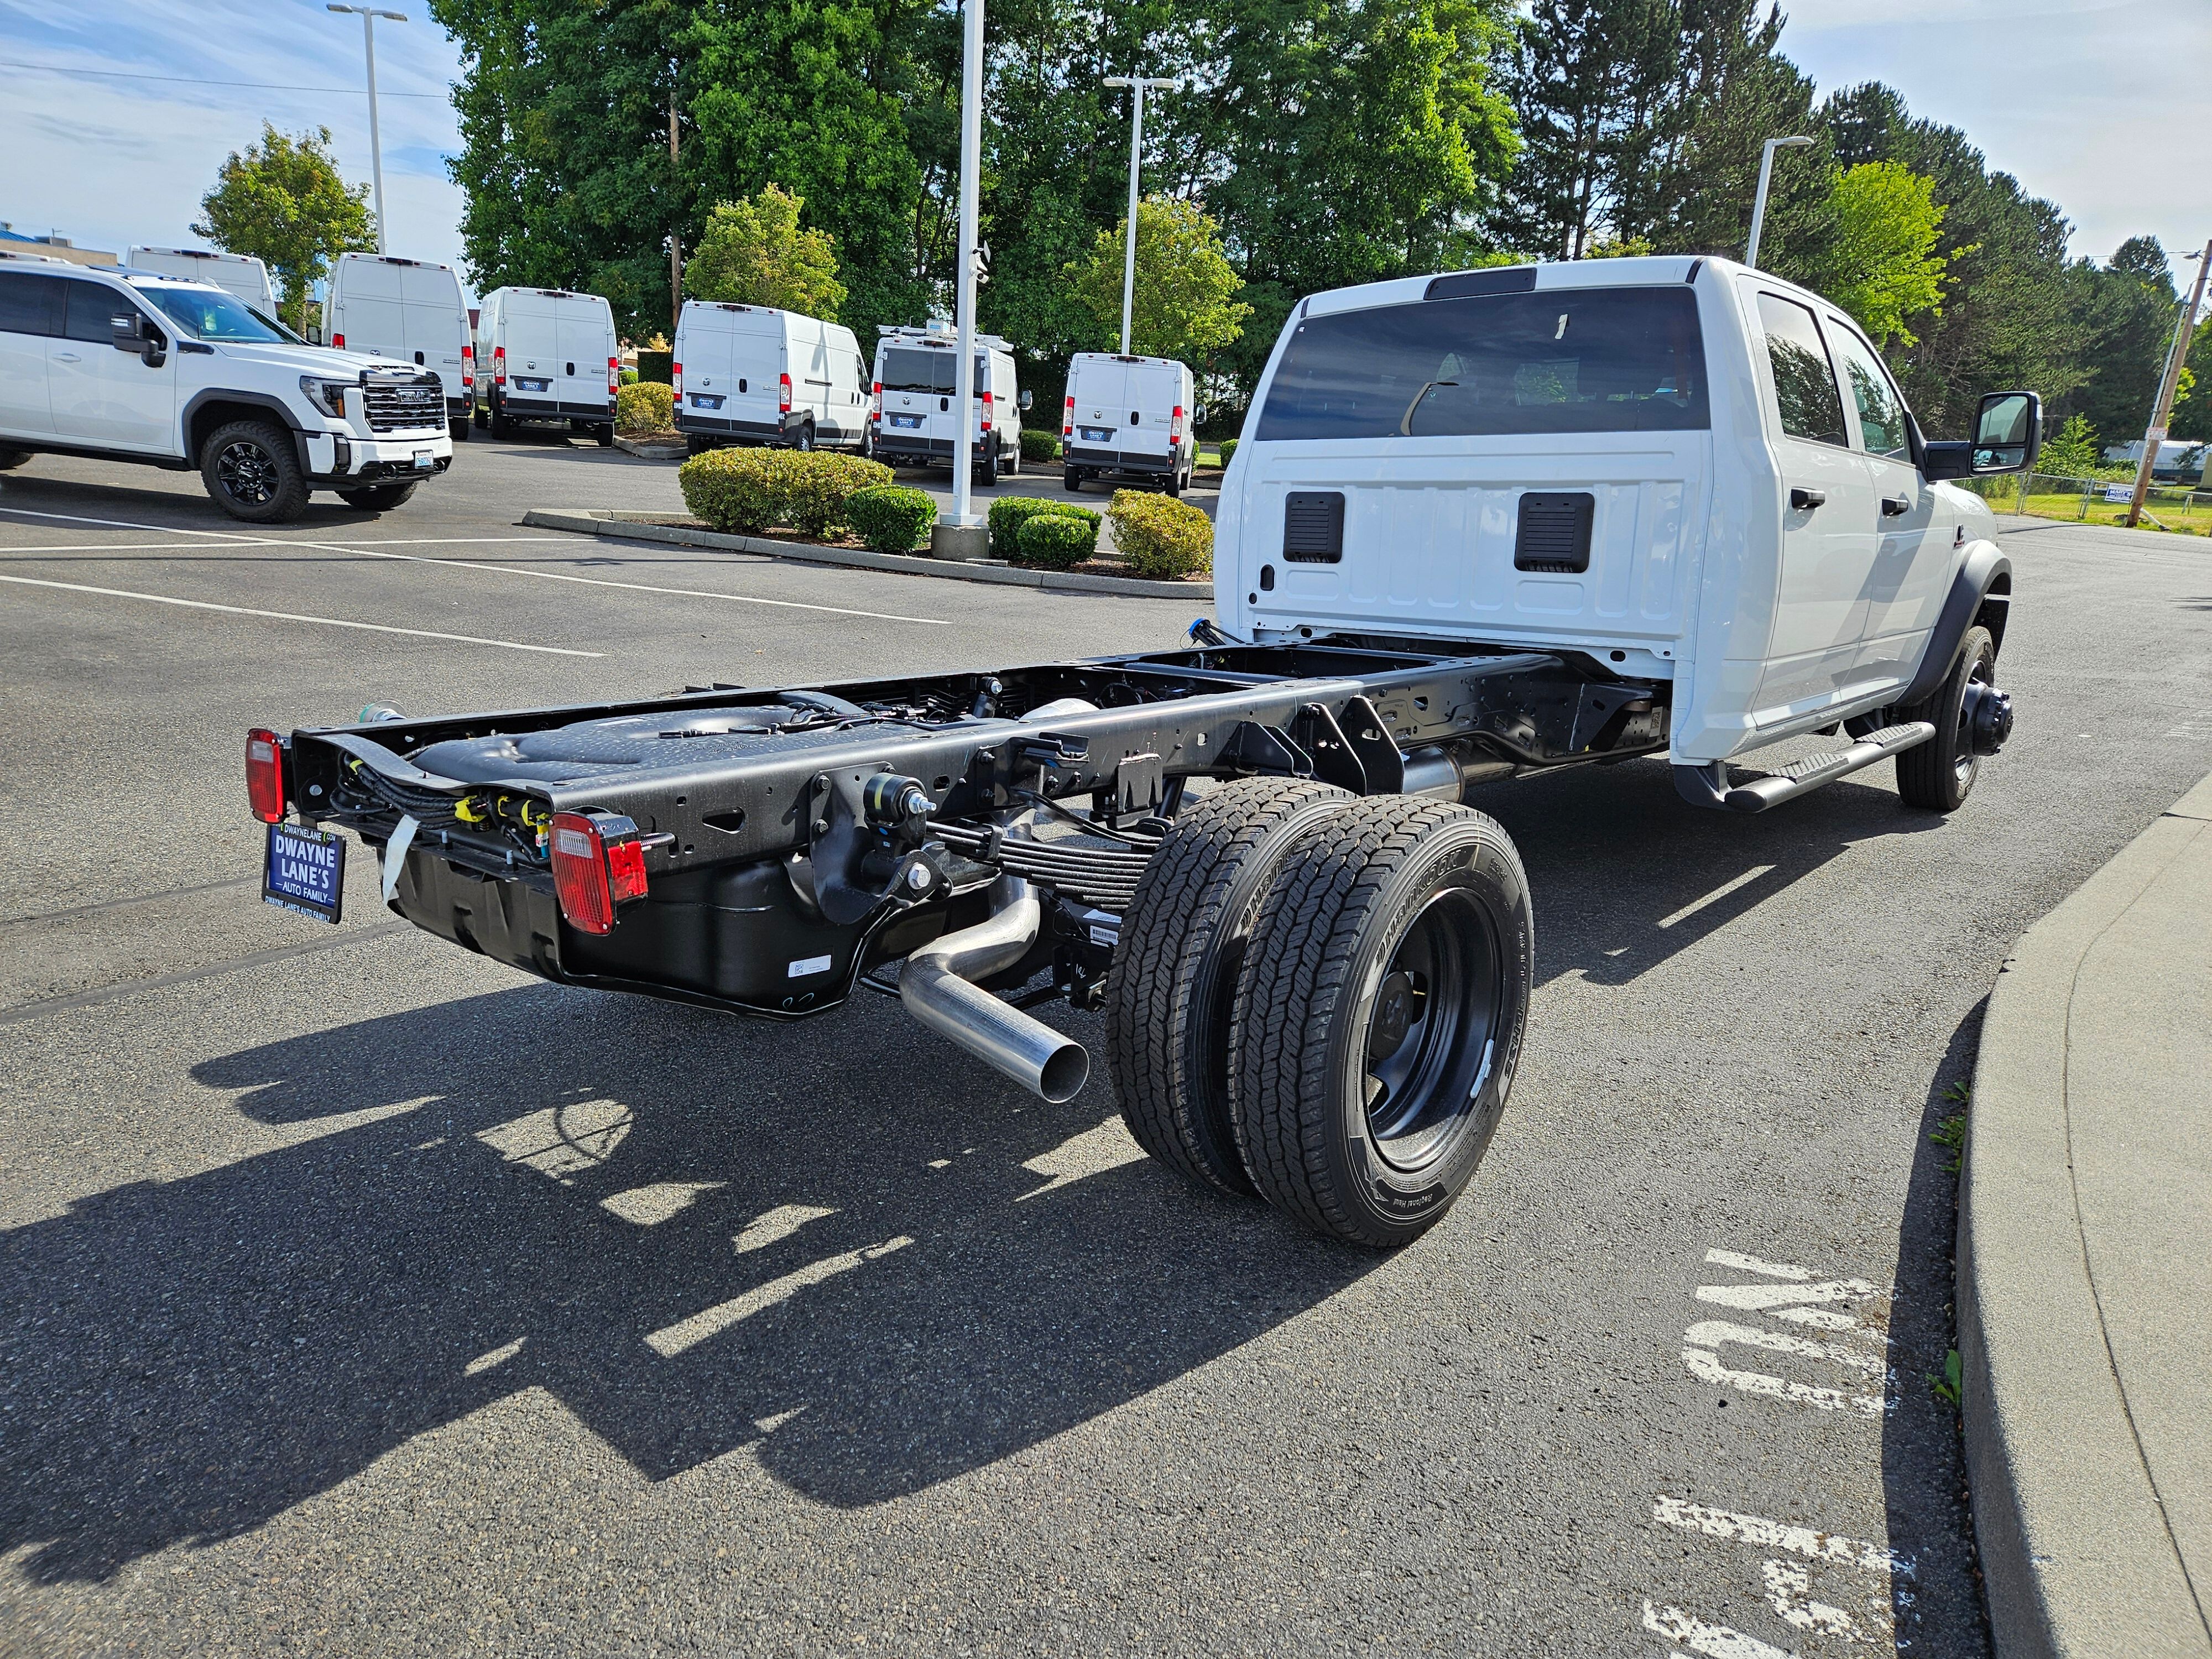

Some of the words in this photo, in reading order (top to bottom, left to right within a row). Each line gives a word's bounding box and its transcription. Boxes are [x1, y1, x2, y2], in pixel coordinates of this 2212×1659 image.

[400, 390, 430, 402] GMC
[284, 825, 322, 841] DWAYNELANE
[275, 834, 335, 868] DWAYNE
[281, 858, 329, 889] LANE'S
[282, 881, 301, 895] AUTO
[303, 888, 328, 904] FAMILY
[265, 895, 284, 907] DWAYNE
[284, 901, 300, 912] LANE'S
[300, 907, 313, 917] AUTO
[312, 911, 331, 923] FAMILY
[1681, 1249, 1901, 1420] NO
